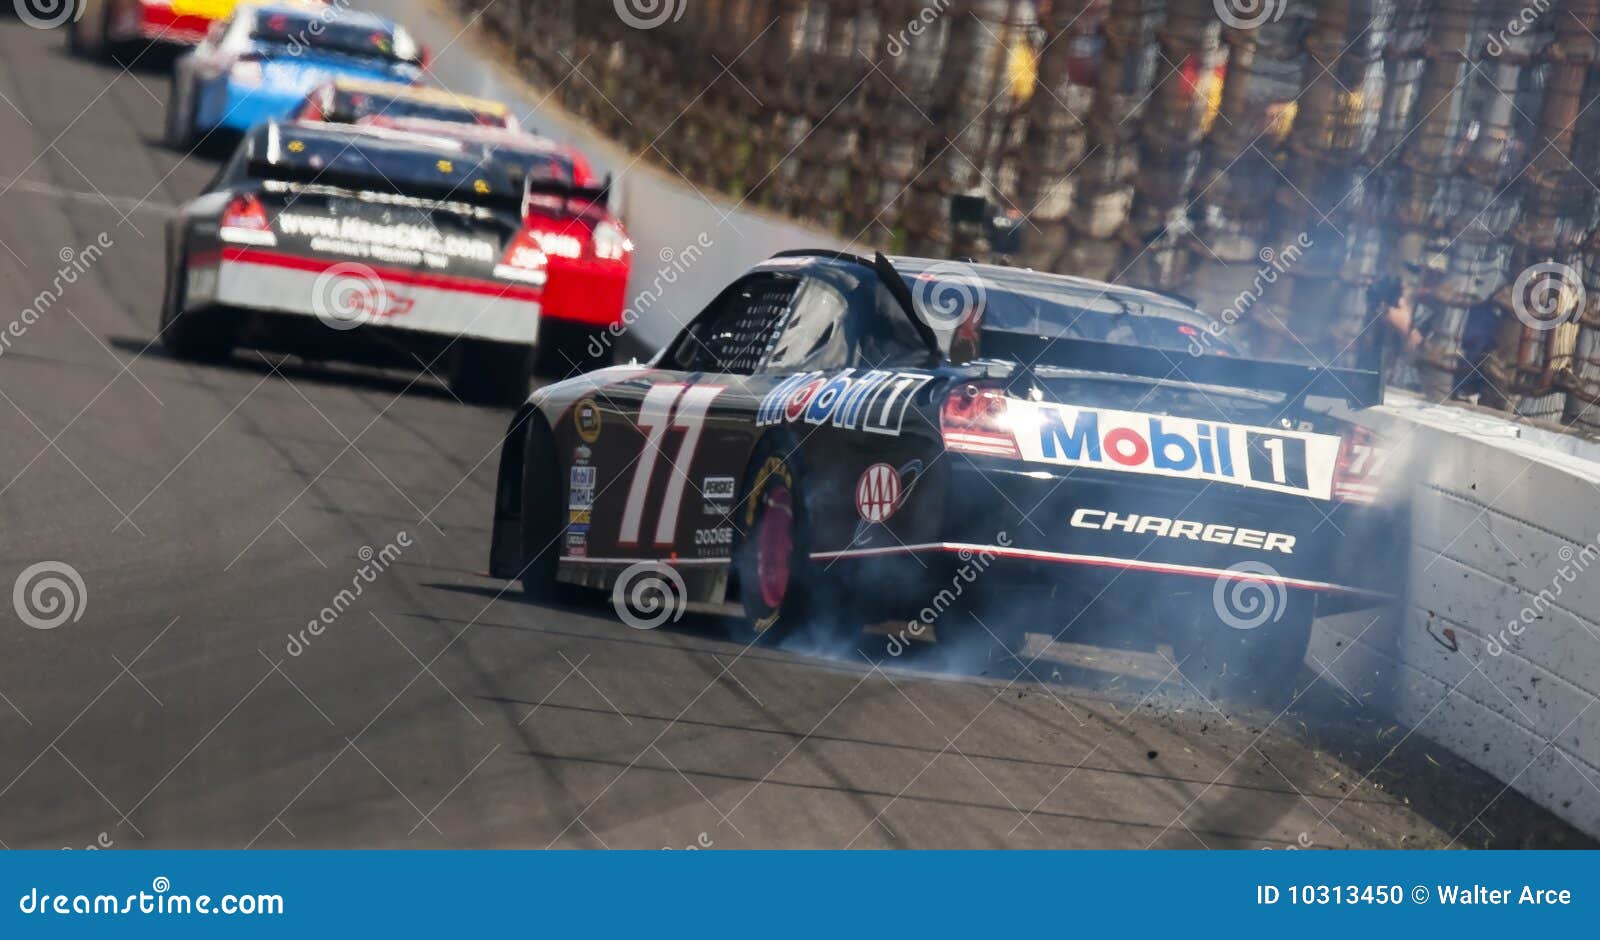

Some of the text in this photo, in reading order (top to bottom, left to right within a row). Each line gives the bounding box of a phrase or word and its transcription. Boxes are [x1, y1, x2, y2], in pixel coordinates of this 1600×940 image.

[756, 368, 893, 430] Mobil
[1038, 407, 1235, 478] Mobil
[695, 528, 733, 544] DODGE
[1070, 508, 1297, 554] CHARGER
